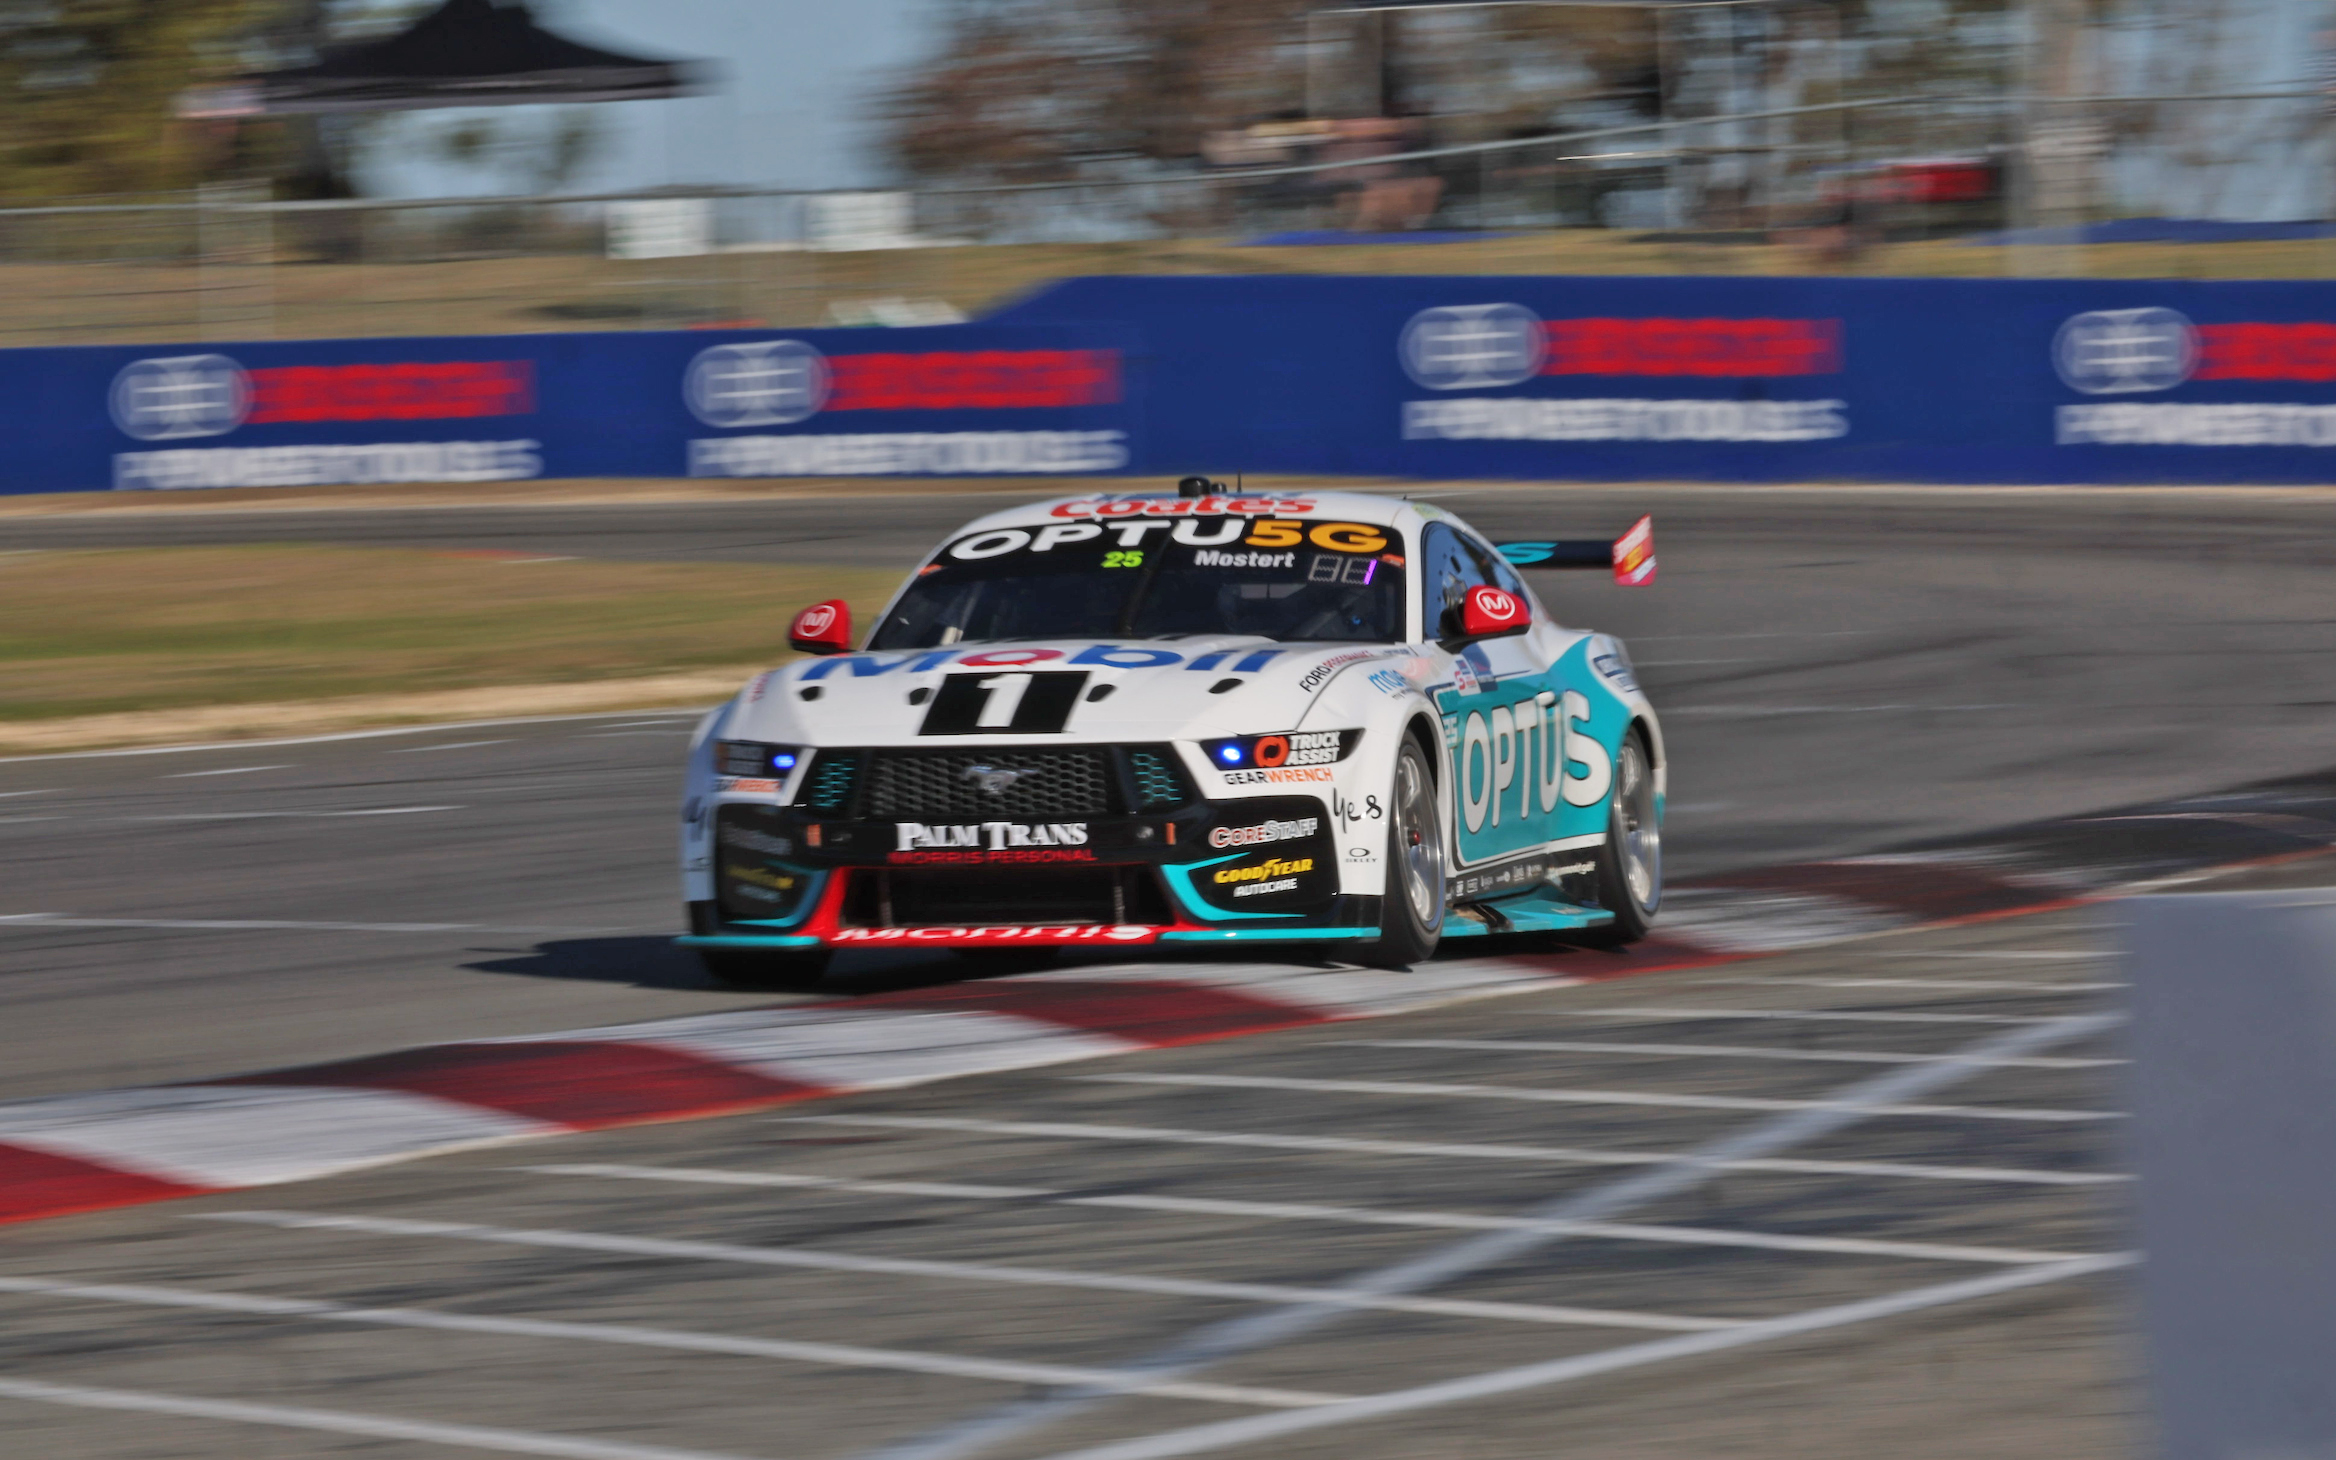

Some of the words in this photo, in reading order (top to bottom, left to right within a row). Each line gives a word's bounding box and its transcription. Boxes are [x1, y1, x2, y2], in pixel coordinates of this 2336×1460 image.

[1101, 550, 1144, 568] 25
[1193, 550, 1295, 568] Mostert
[798, 644, 1286, 680] Mobil
[1299, 665, 1332, 693] FORD
[976, 673, 1032, 728] 1
[1289, 732, 1341, 750] TRUCK
[1285, 747, 1340, 765] ASSIST
[1461, 690, 1612, 835] OPTUS
[1224, 768, 1334, 785] GEARWRENCH
[895, 822, 981, 851] PALM
[981, 821, 1088, 850] TRANS
[986, 849, 1098, 864] PERSONAL
[1213, 858, 1315, 884] GOODYEAR
[1233, 878, 1298, 897] AUTOCARE
